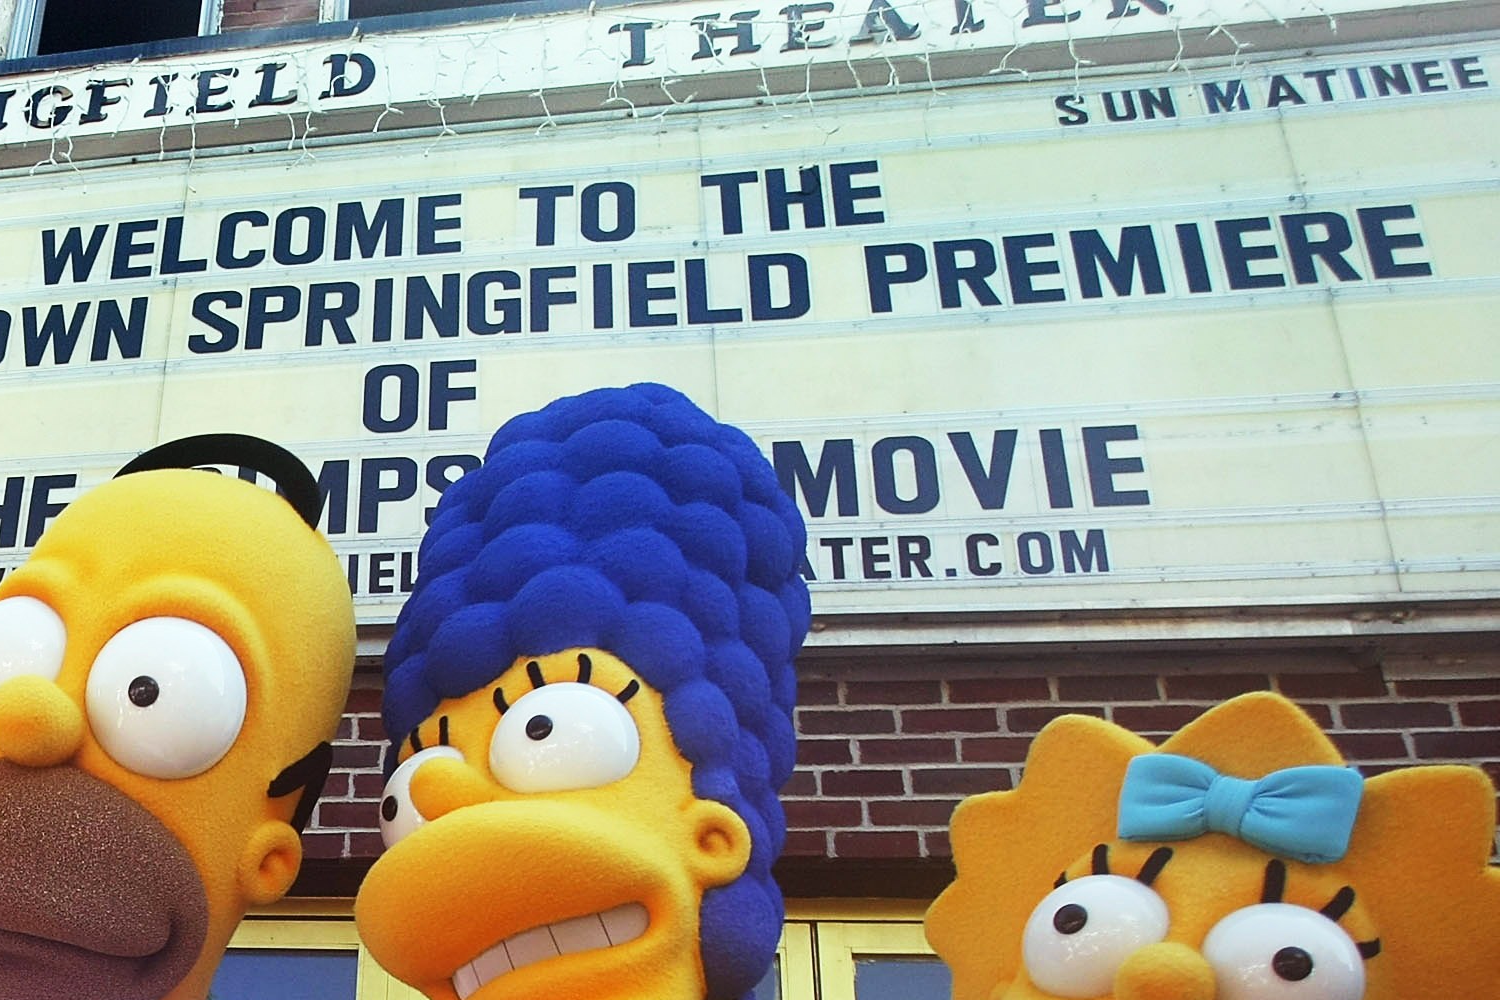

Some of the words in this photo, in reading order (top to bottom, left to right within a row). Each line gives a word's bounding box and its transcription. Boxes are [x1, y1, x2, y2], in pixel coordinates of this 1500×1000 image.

[1053, 86, 1178, 127] SUN
[1200, 56, 1489, 114] MATINEE
[41, 193, 462, 286] WELCOME
[519, 181, 636, 247] TO
[700, 160, 886, 235] THE
[187, 252, 811, 355] SPRINGFIELD
[863, 203, 1433, 314] PREMIERE
[362, 359, 477, 433] OF
[771, 424, 1151, 518] MOVIE
